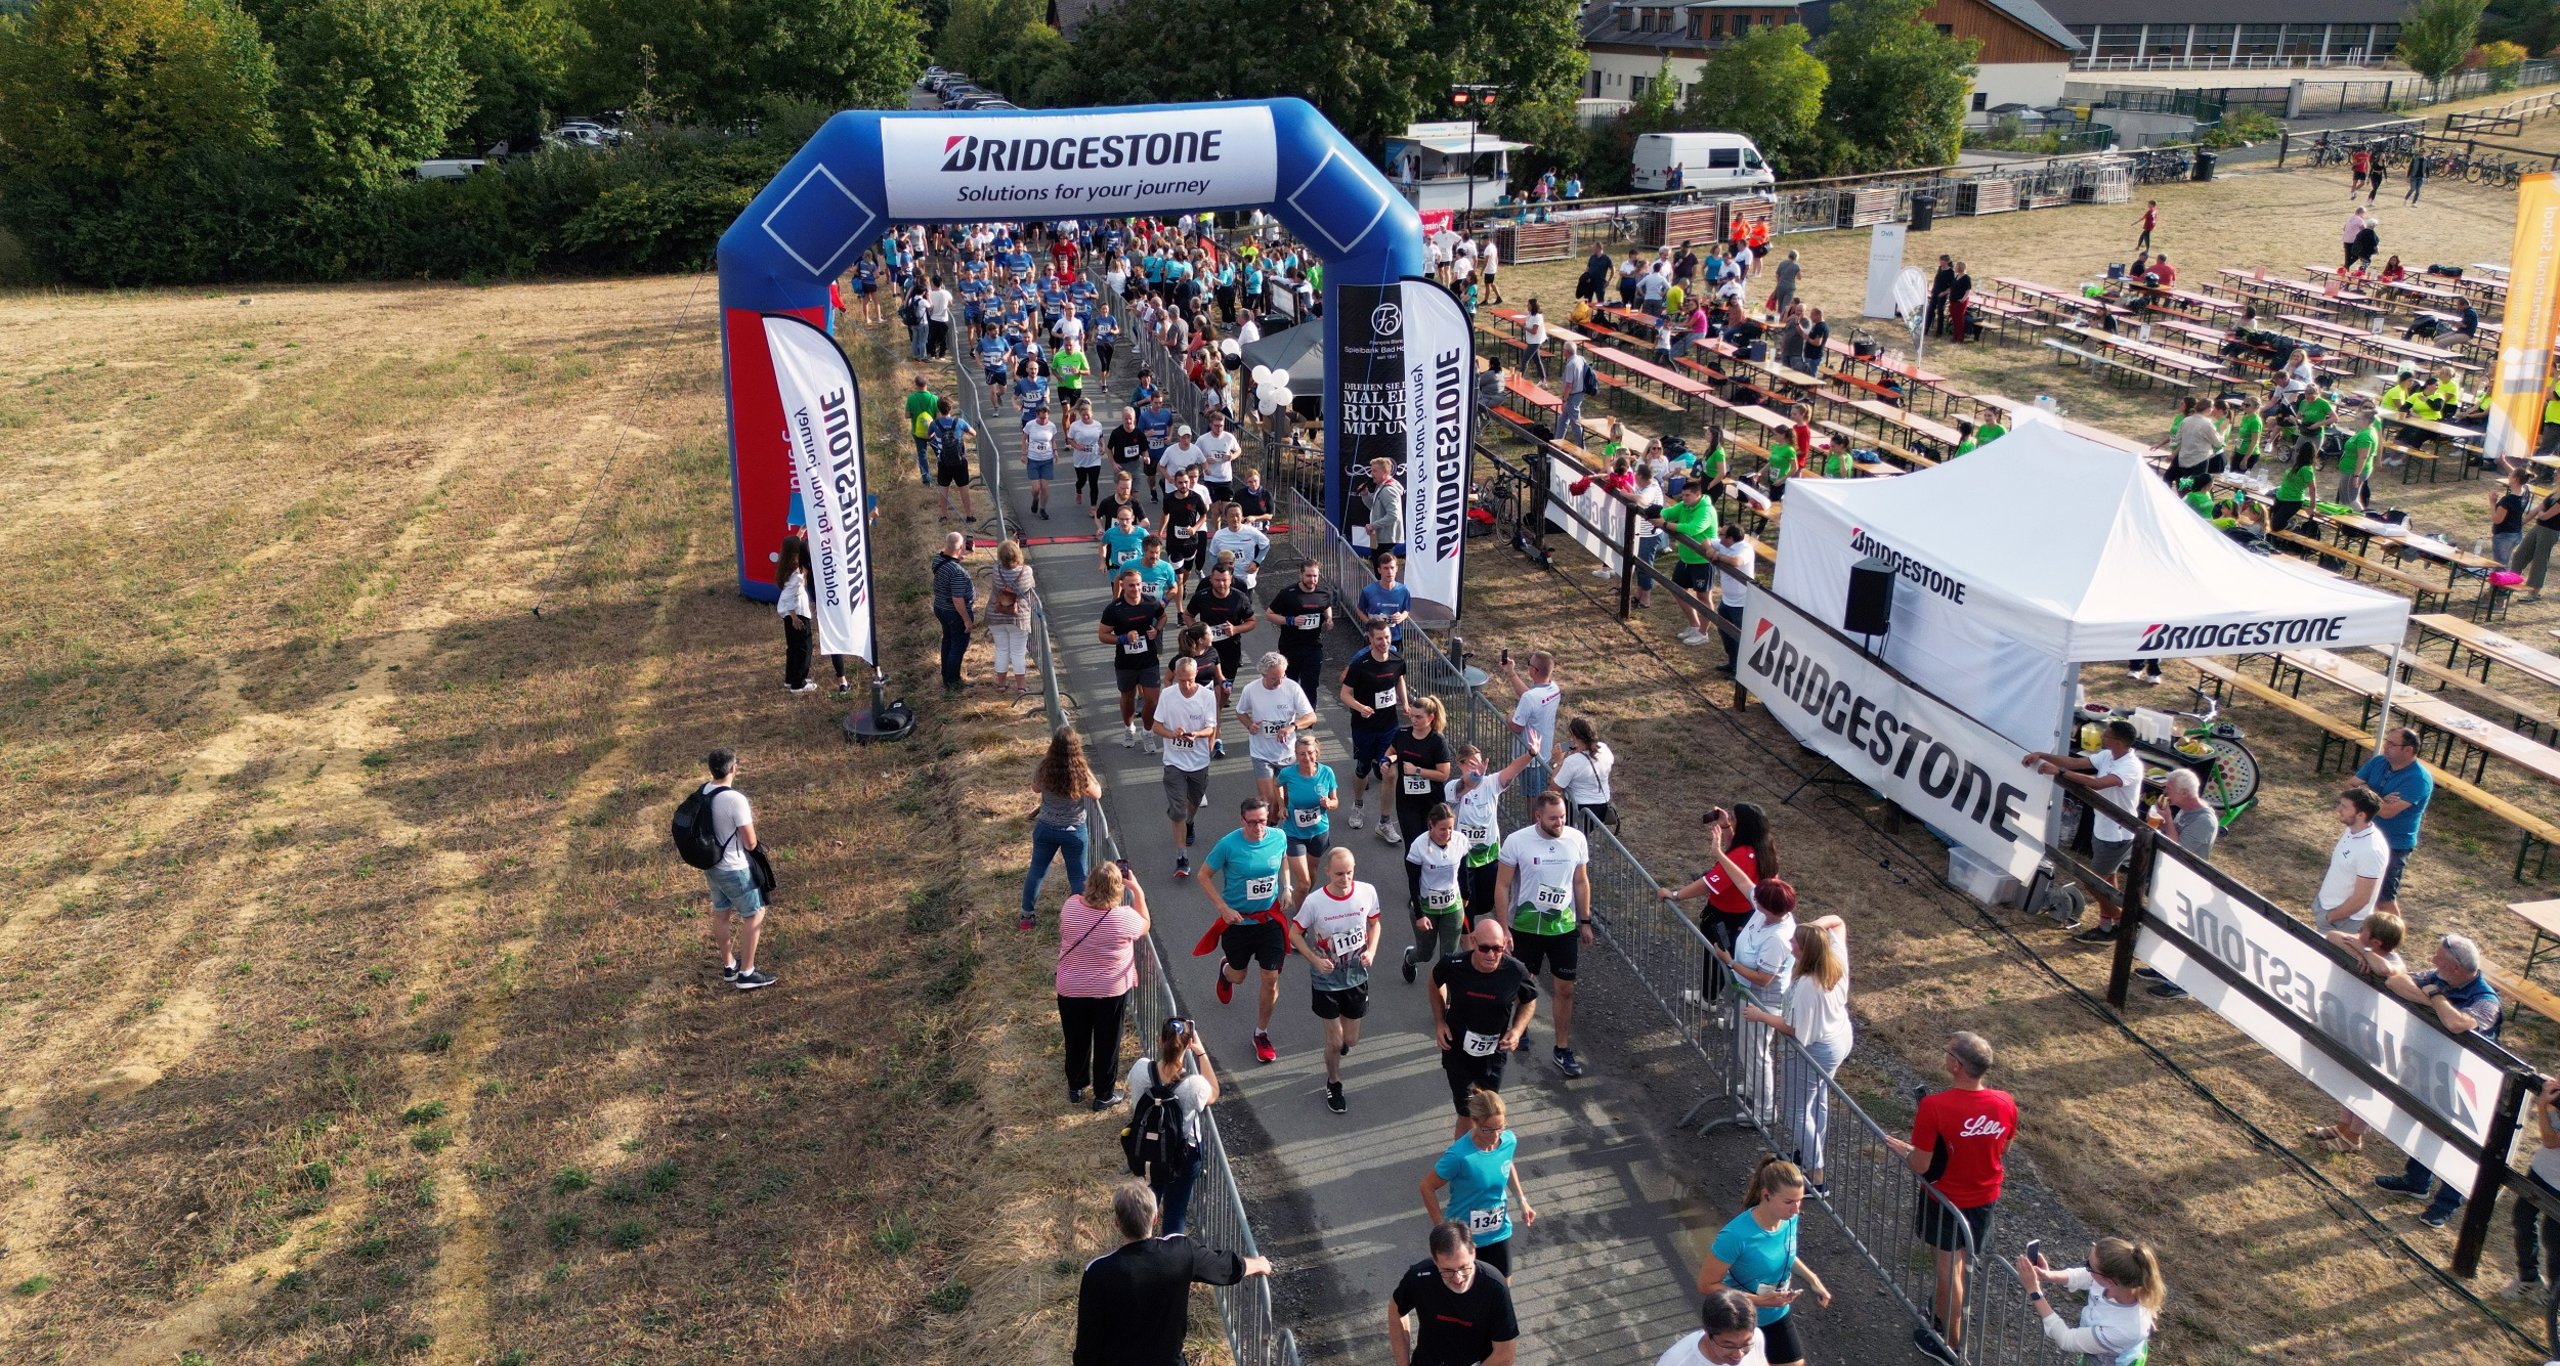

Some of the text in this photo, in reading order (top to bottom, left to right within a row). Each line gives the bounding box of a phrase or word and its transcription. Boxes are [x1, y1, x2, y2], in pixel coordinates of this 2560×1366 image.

[940, 129, 1222, 172] BRIDGESTONE
[957, 178, 1210, 202] Solutions for your journey
[1344, 346, 1379, 354] Spielbank
[1344, 382, 1383, 391] DREHEN
[1385, 382, 1400, 391] SIE
[1343, 390, 1383, 404] MAL
[1343, 402, 1407, 421] RUND
[1343, 420, 1407, 435] MIT UN
[1850, 527, 1966, 605] BRIDGESTONE
[2136, 616, 2348, 652] BRIDGESTONE
[1379, 693, 1394, 704] 760
[1748, 617, 2028, 843] BRIDGESTONE
[1408, 781, 1426, 790] 758
[1299, 812, 1318, 823] 664
[1461, 829, 1486, 839] 5102
[1252, 882, 1273, 895] 662
[1538, 890, 1566, 905] 5107
[1336, 931, 1363, 949] 1103
[1470, 1039, 1494, 1052] 757
[1959, 1114, 2006, 1140] Lilly
[1473, 1212, 1504, 1230] 1343
